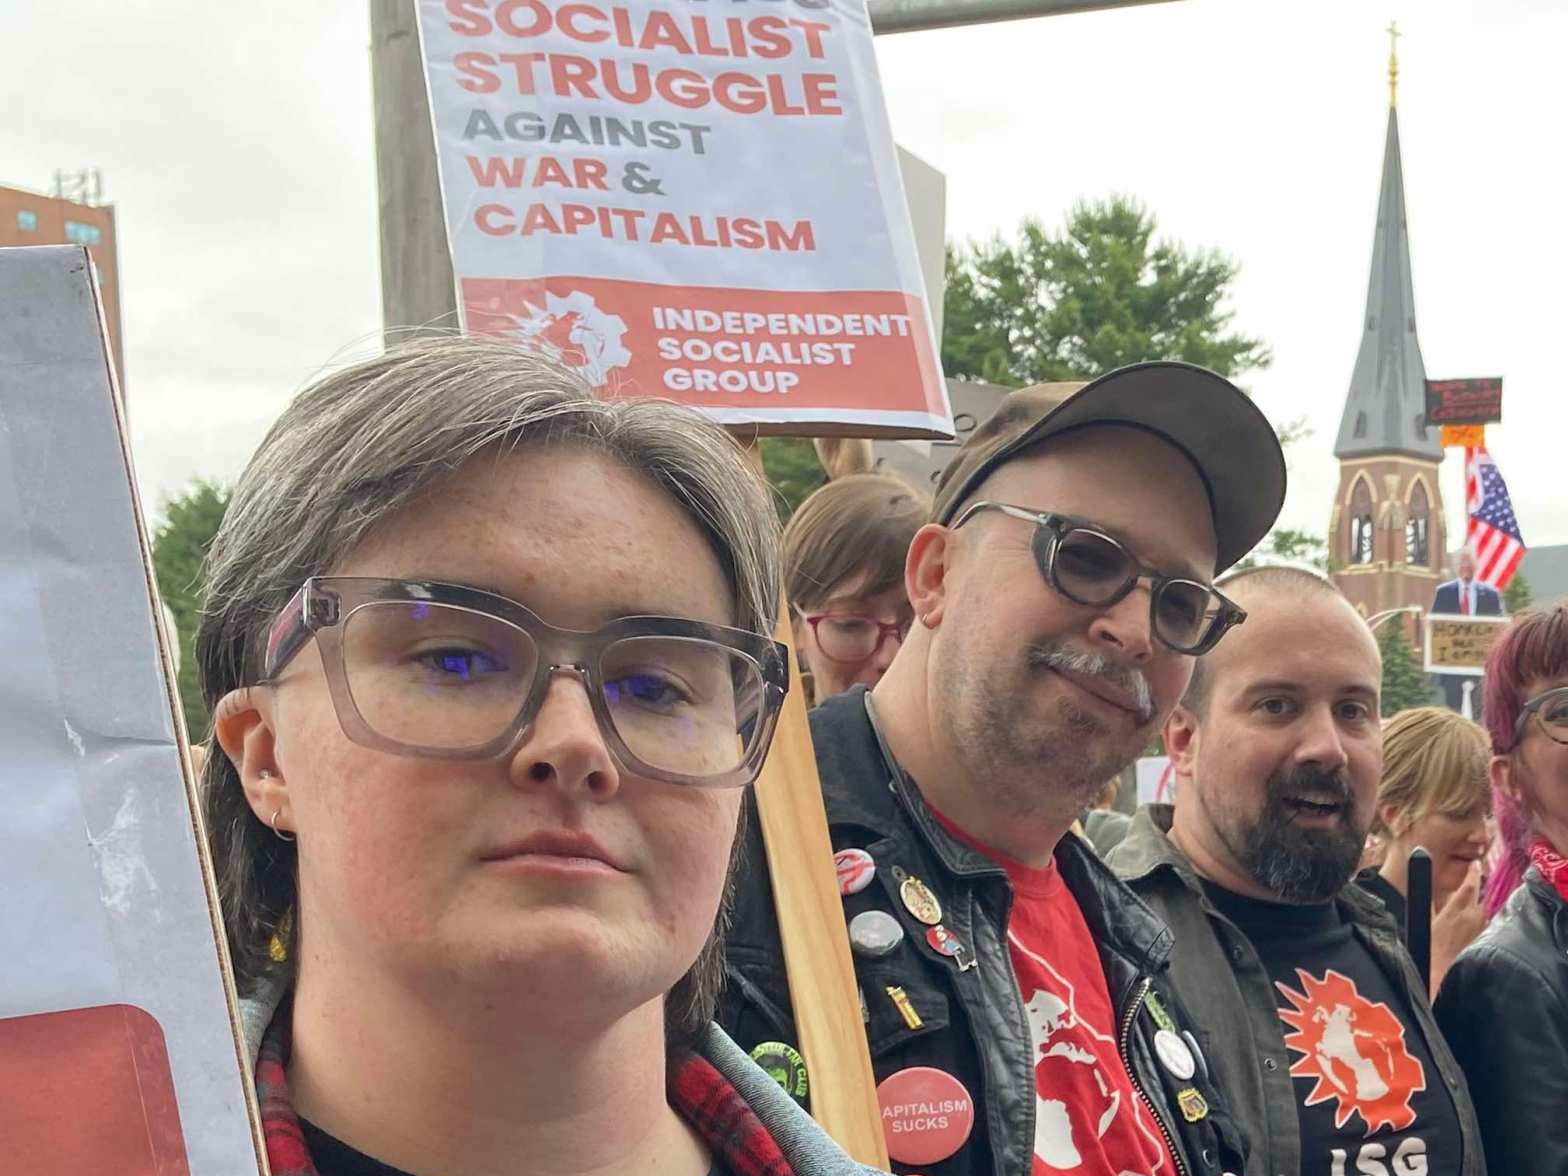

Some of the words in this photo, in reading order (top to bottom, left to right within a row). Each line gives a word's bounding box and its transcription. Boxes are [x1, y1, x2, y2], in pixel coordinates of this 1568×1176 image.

[446, 0, 832, 58] SOCIALIST
[453, 51, 843, 115] STRUGGLE
[464, 109, 711, 154] AGAINST
[467, 156, 609, 191] WAR
[621, 162, 665, 196] &
[474, 203, 816, 251] CAPITALISM
[652, 307, 912, 337] INDEPENDENT
[657, 337, 856, 365] SOCIALIST
[663, 367, 799, 393] GROUP
[883, 1100, 967, 1119] APITALISM
[892, 1116, 949, 1133] SUCKS
